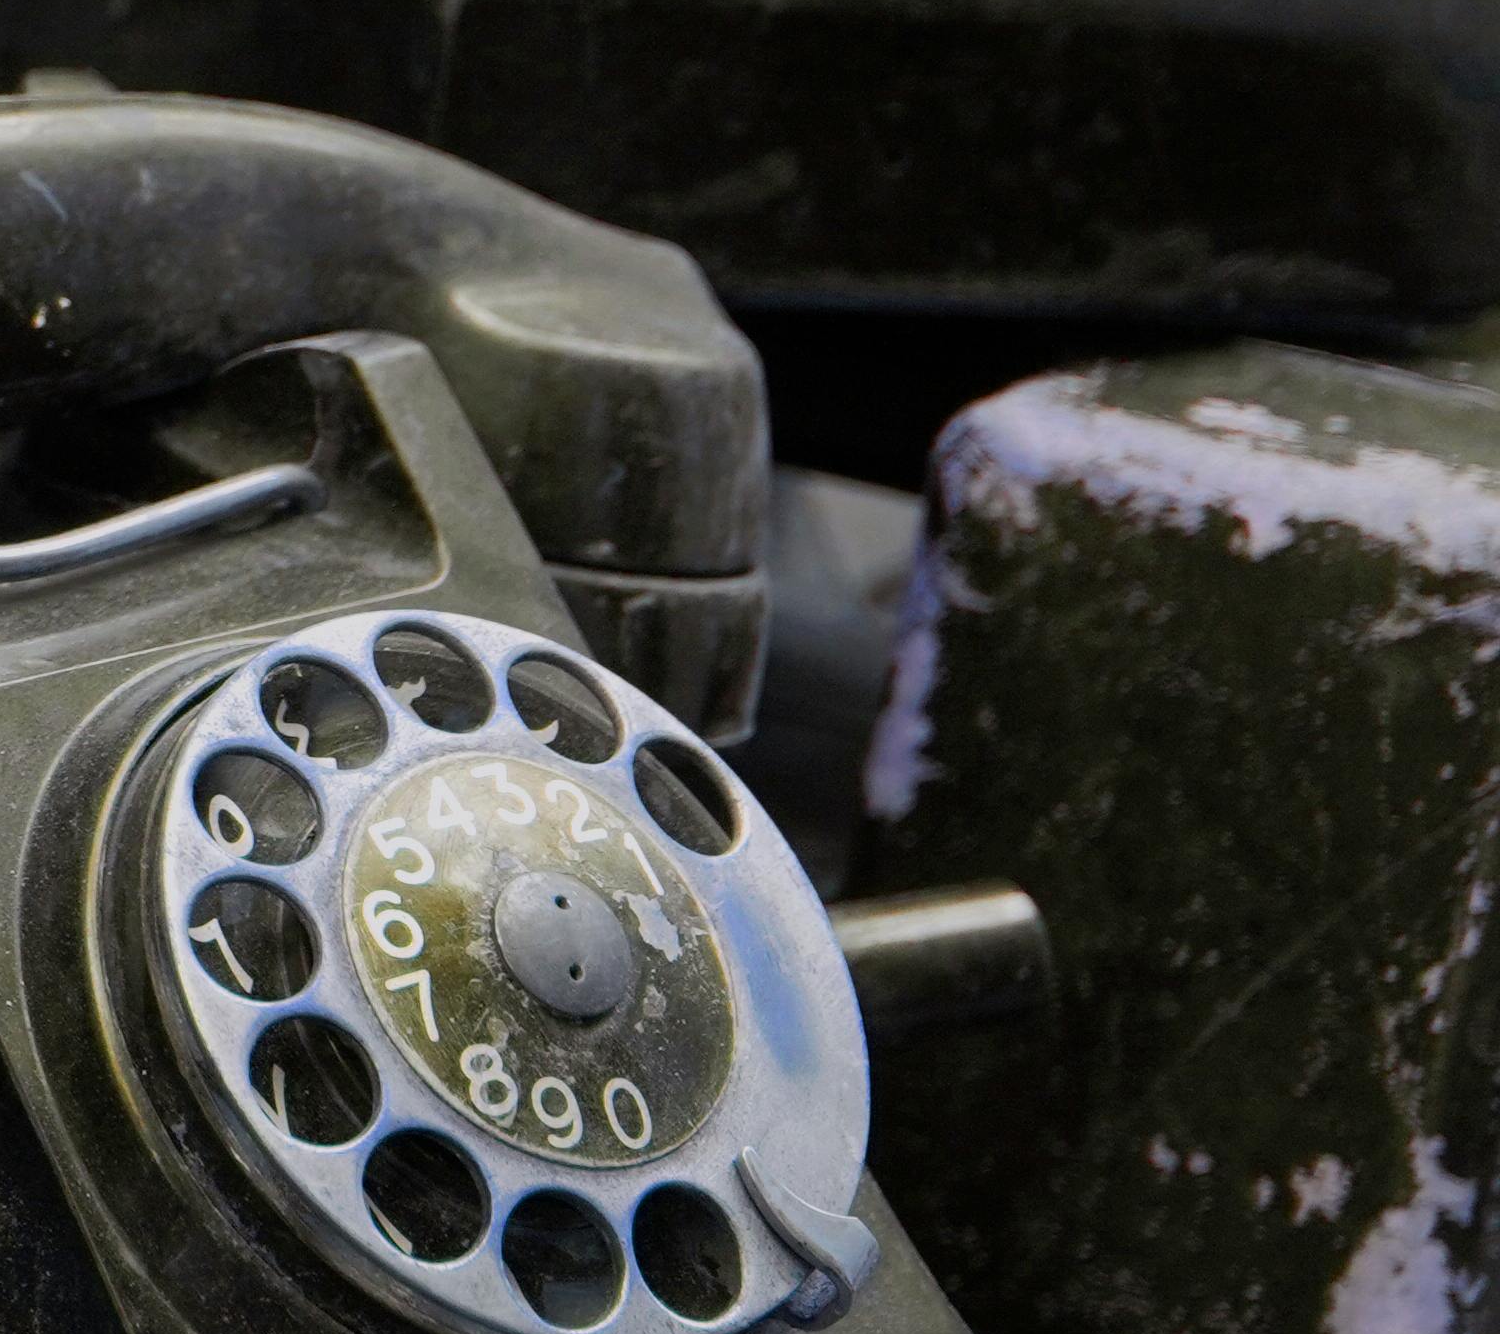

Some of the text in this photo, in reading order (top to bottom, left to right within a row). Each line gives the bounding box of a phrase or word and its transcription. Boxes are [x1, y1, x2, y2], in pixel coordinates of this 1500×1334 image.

[362, 762, 665, 1150] 1 2 3 4 5 6 7 8 9 0
